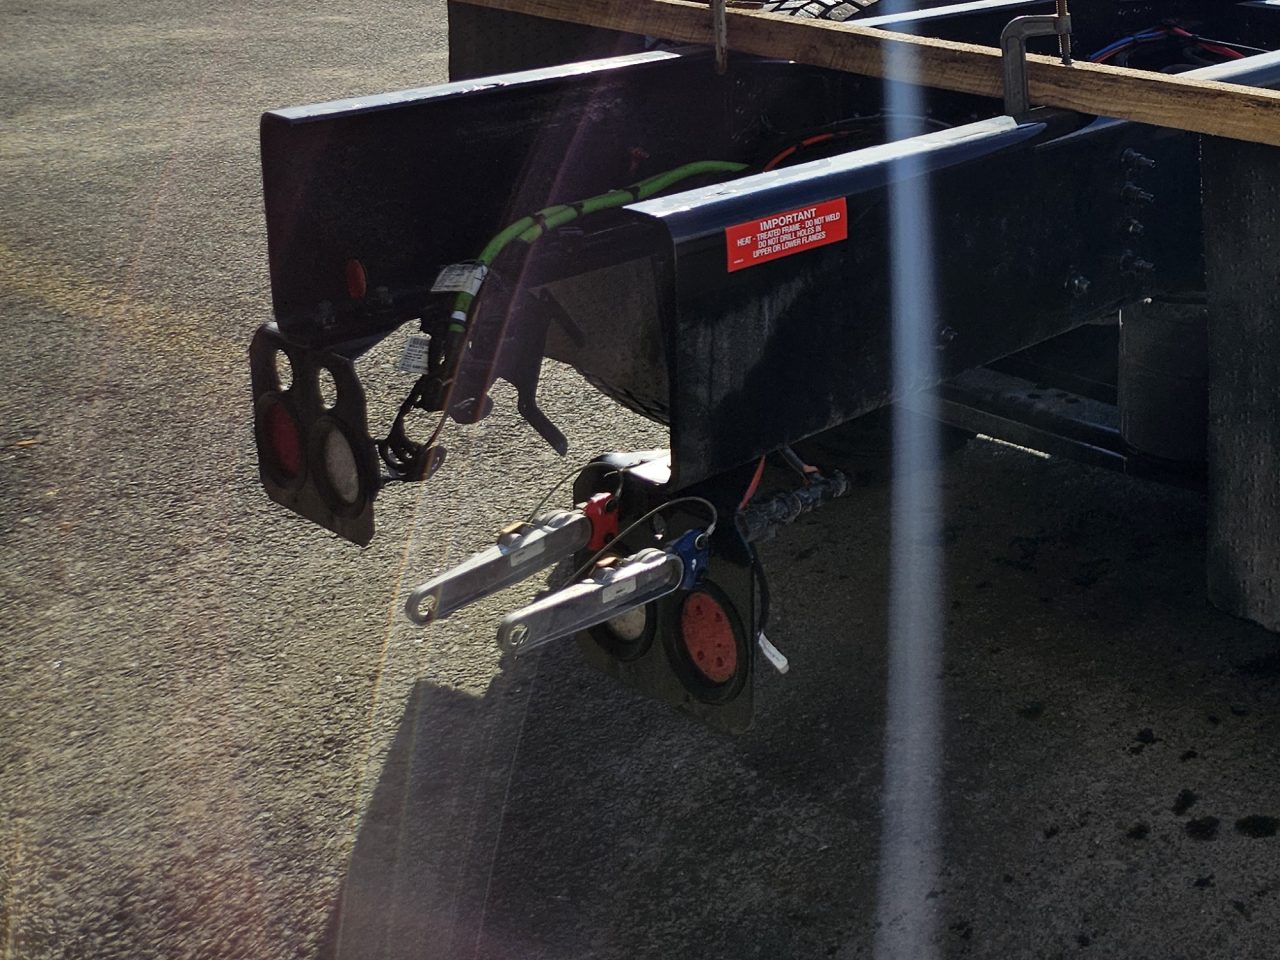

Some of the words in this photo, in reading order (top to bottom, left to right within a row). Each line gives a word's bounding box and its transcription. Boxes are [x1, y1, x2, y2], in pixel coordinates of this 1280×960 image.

[737, 236, 752, 247] HEAT
[757, 228, 781, 241] TREATED
[782, 223, 801, 234] FRAME
[805, 219, 814, 228] DO
[814, 216, 825, 225] NOT
[825, 212, 841, 223] WELD
[760, 208, 817, 231] IMPORTANT
[753, 246, 772, 258] UPPER
[773, 243, 781, 253] OR
[782, 239, 801, 250] LOWER
[801, 231, 827, 244] FLANGES
[758, 240, 767, 249] DO
[768, 237, 779, 246] NOT
[780, 233, 796, 243] DRILL
[796, 227, 815, 238] HOLES
